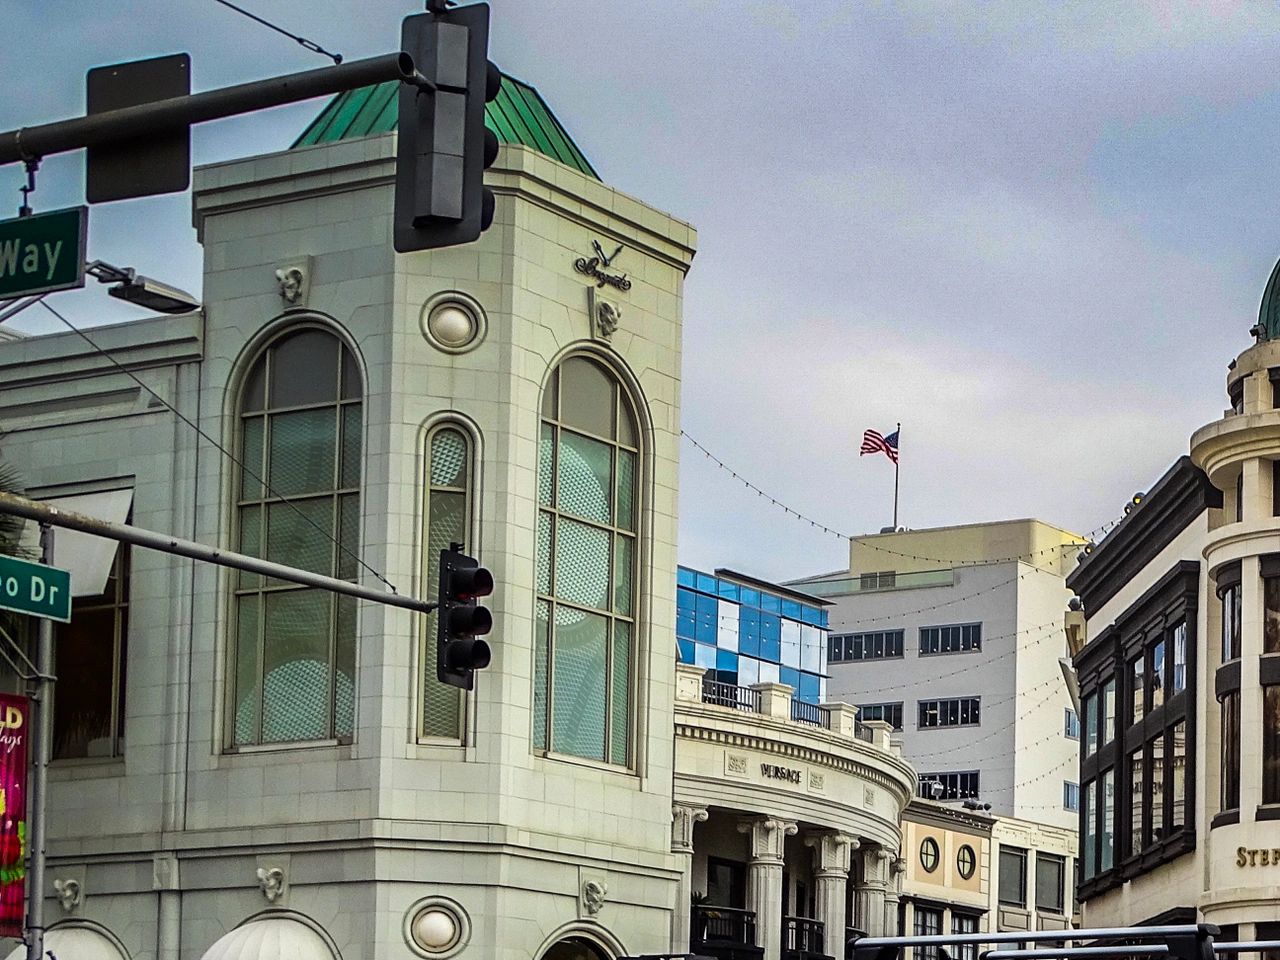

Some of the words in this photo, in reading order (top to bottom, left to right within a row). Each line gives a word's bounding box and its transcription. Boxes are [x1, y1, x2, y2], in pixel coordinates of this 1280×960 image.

[0, 238, 63, 280] Way
[31, 575, 59, 605] Dr
[760, 763, 801, 784] VERSACE
